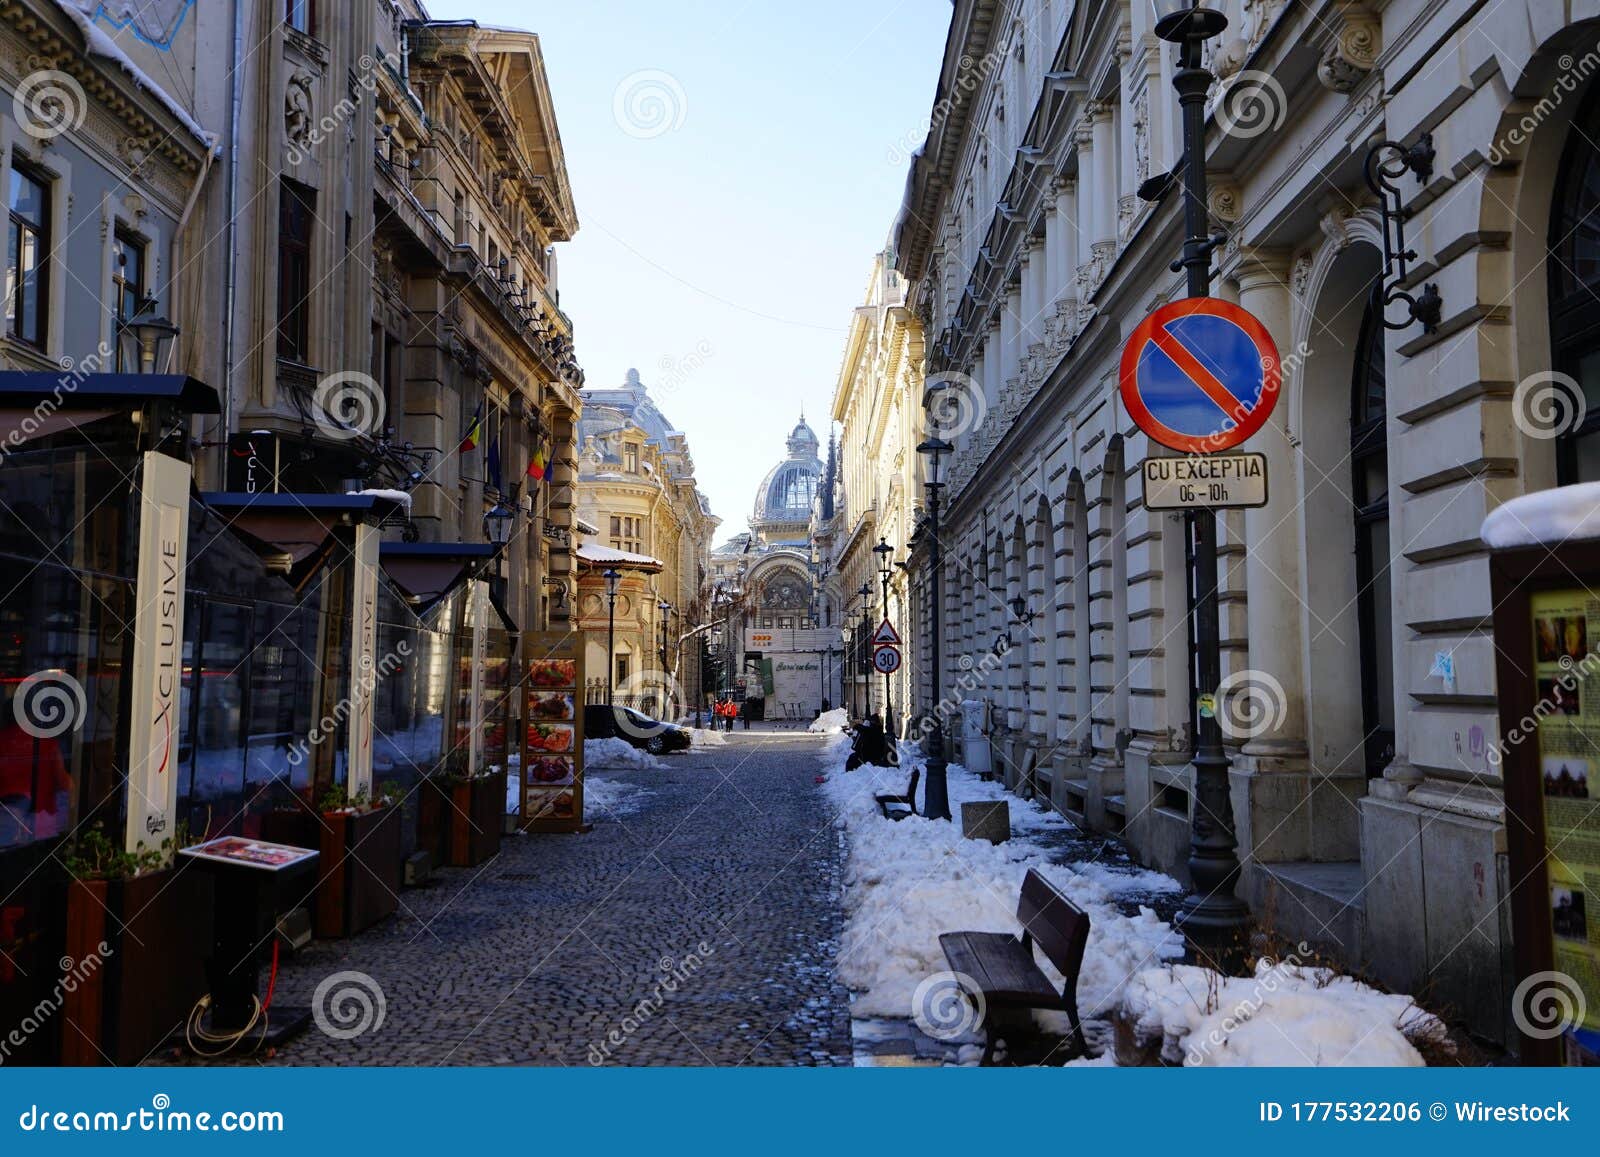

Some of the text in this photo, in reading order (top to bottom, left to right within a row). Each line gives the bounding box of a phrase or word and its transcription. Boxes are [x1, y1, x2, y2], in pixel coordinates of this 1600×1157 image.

[1148, 461, 1169, 481] CU
[154, 539, 177, 774] XCLUSIVE
[880, 652, 894, 667] 30
